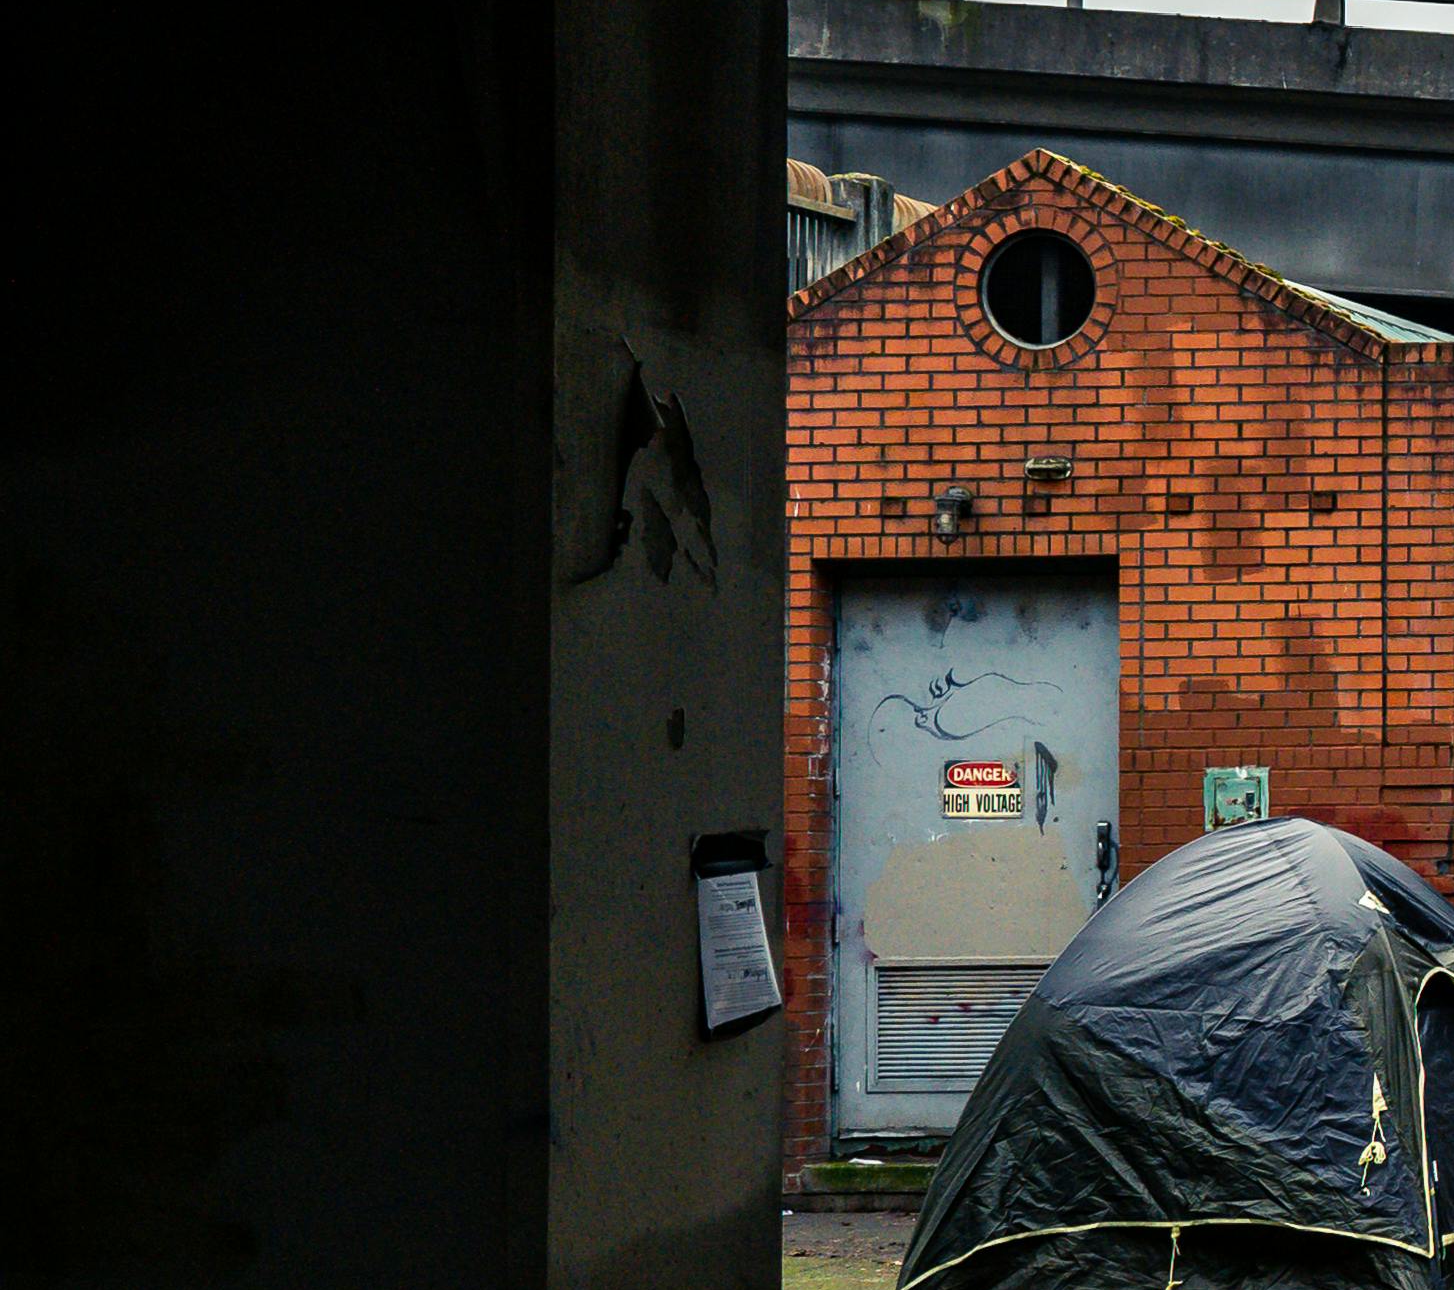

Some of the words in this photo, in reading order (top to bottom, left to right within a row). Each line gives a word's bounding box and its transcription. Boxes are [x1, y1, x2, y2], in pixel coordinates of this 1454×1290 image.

[953, 767, 1011, 782] DANGER
[943, 793, 970, 813] HIGH
[976, 793, 1022, 813] VOLTAGE
